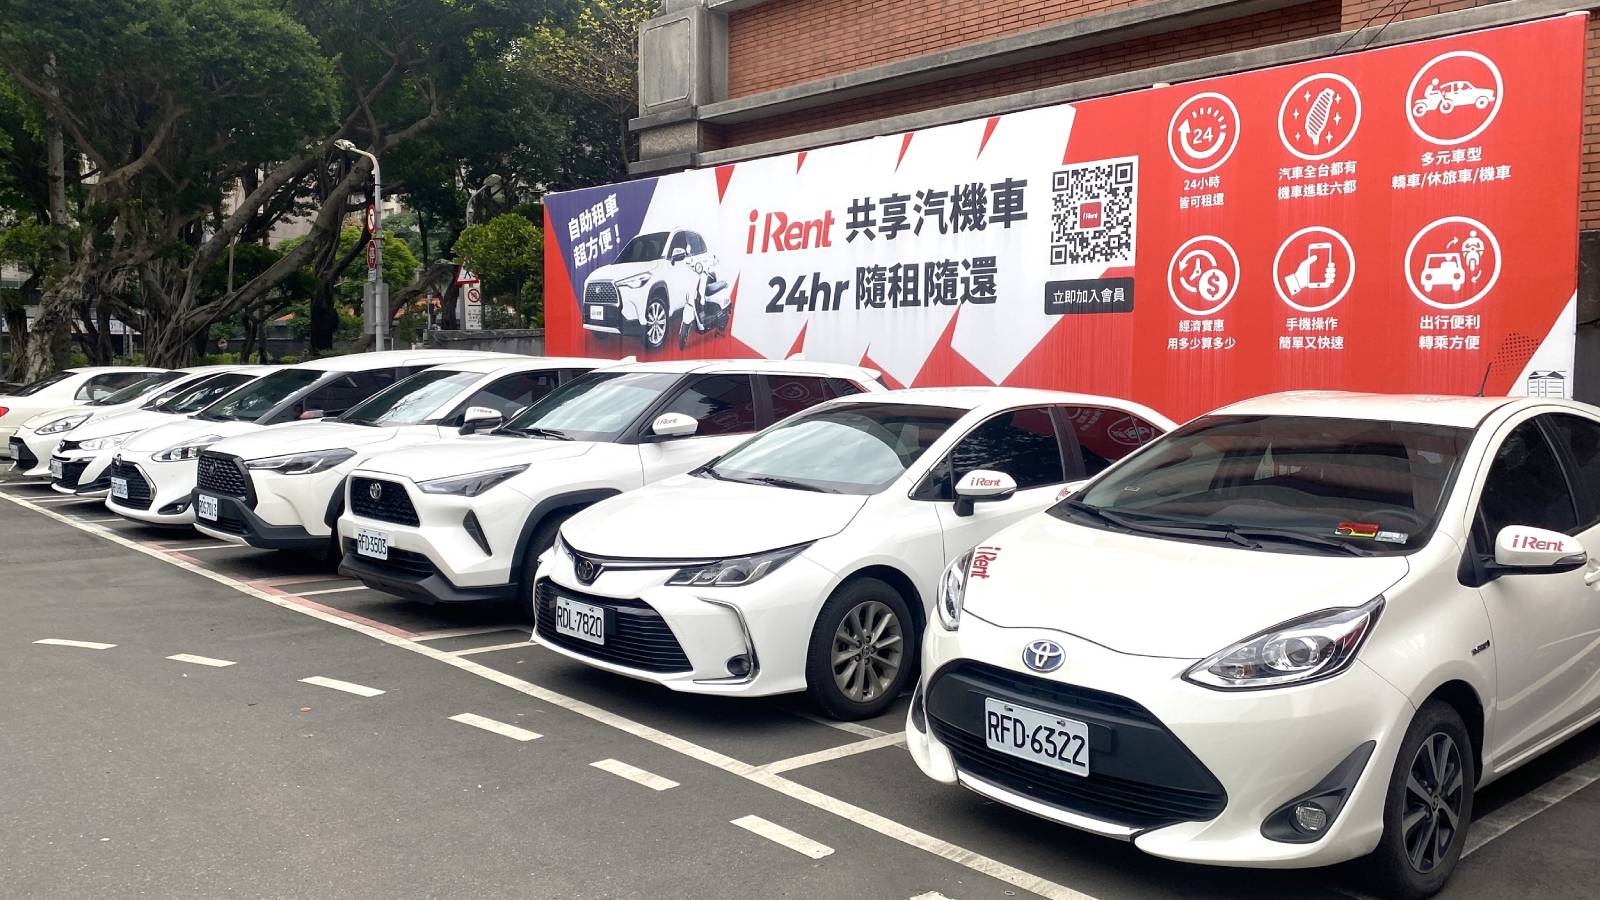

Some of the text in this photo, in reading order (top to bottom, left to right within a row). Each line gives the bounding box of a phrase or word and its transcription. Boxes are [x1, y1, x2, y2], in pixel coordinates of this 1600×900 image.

[1421, 146, 1482, 166] 多元車型
[1278, 160, 1358, 181] 汽車全台都有
[1391, 165, 1511, 189] 轎車/休旅車/機車
[1183, 175, 1221, 191] 24小時
[1277, 179, 1357, 200] 機車進駐六都
[1179, 193, 1225, 209] 皆可租還
[568, 193, 619, 242] 自助租車
[845, 178, 1028, 244] 共享汽機車
[765, 255, 998, 314] 24hr 隨租隨還
[1052, 287, 1125, 306] 立即加入會員
[1178, 318, 1225, 333] 經濟實惠
[1285, 317, 1338, 332] 手機操作
[1419, 315, 1481, 330] 出行便利
[1167, 336, 1237, 350] 用多少算多少
[1279, 335, 1345, 350] 簡單又快速
[1418, 335, 1481, 350] 轉乘方便
